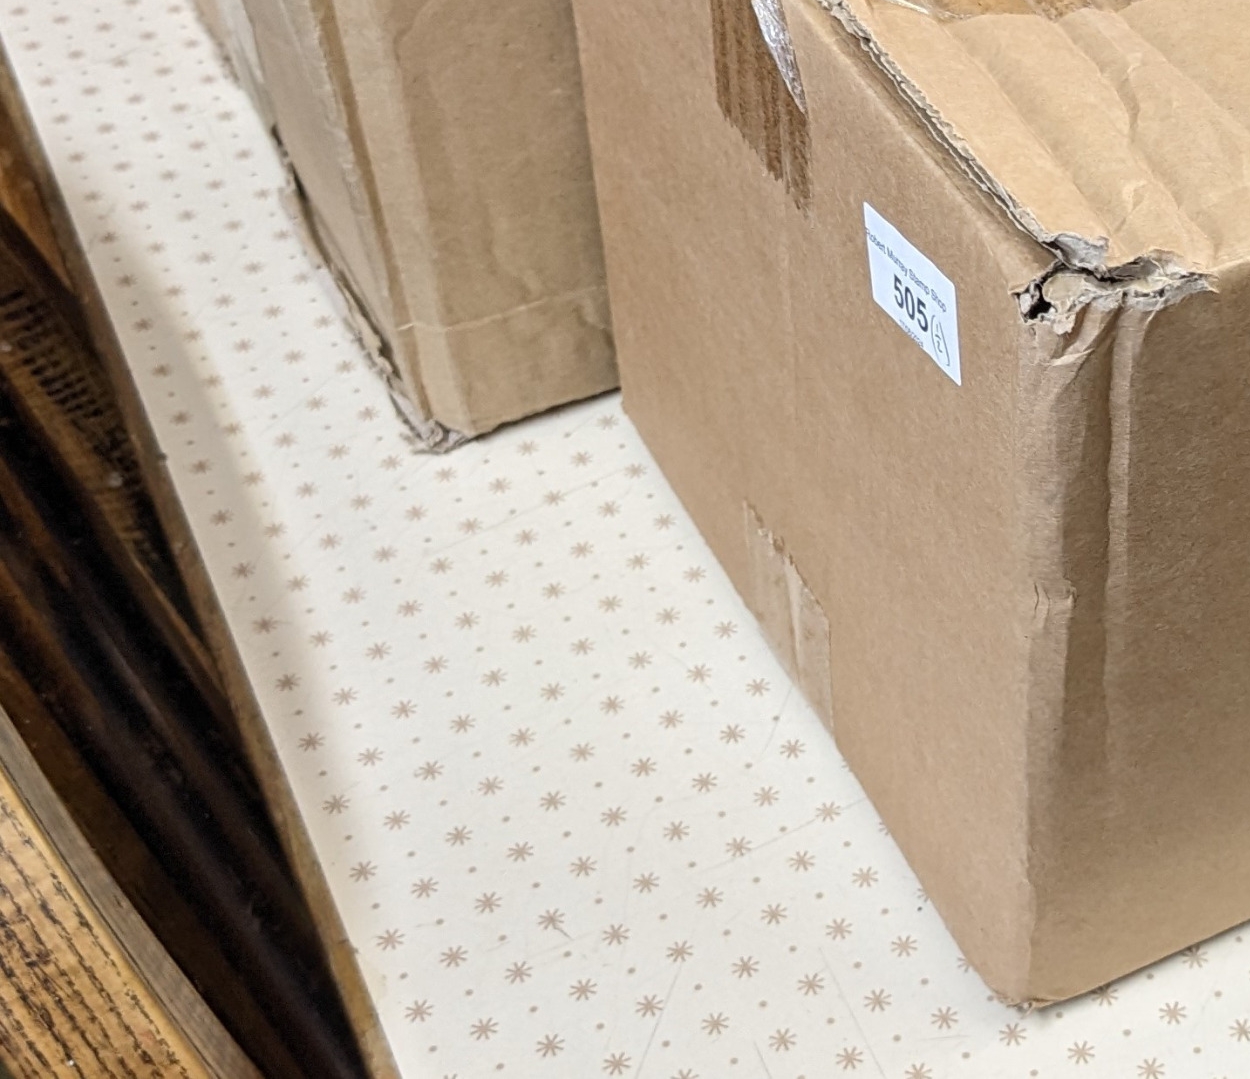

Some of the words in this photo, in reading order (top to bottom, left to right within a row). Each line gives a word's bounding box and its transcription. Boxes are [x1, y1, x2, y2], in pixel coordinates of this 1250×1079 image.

[886, 246, 908, 277] Murray
[908, 268, 930, 296] Stamp
[930, 288, 947, 313] Shop
[894, 274, 929, 333] 505
